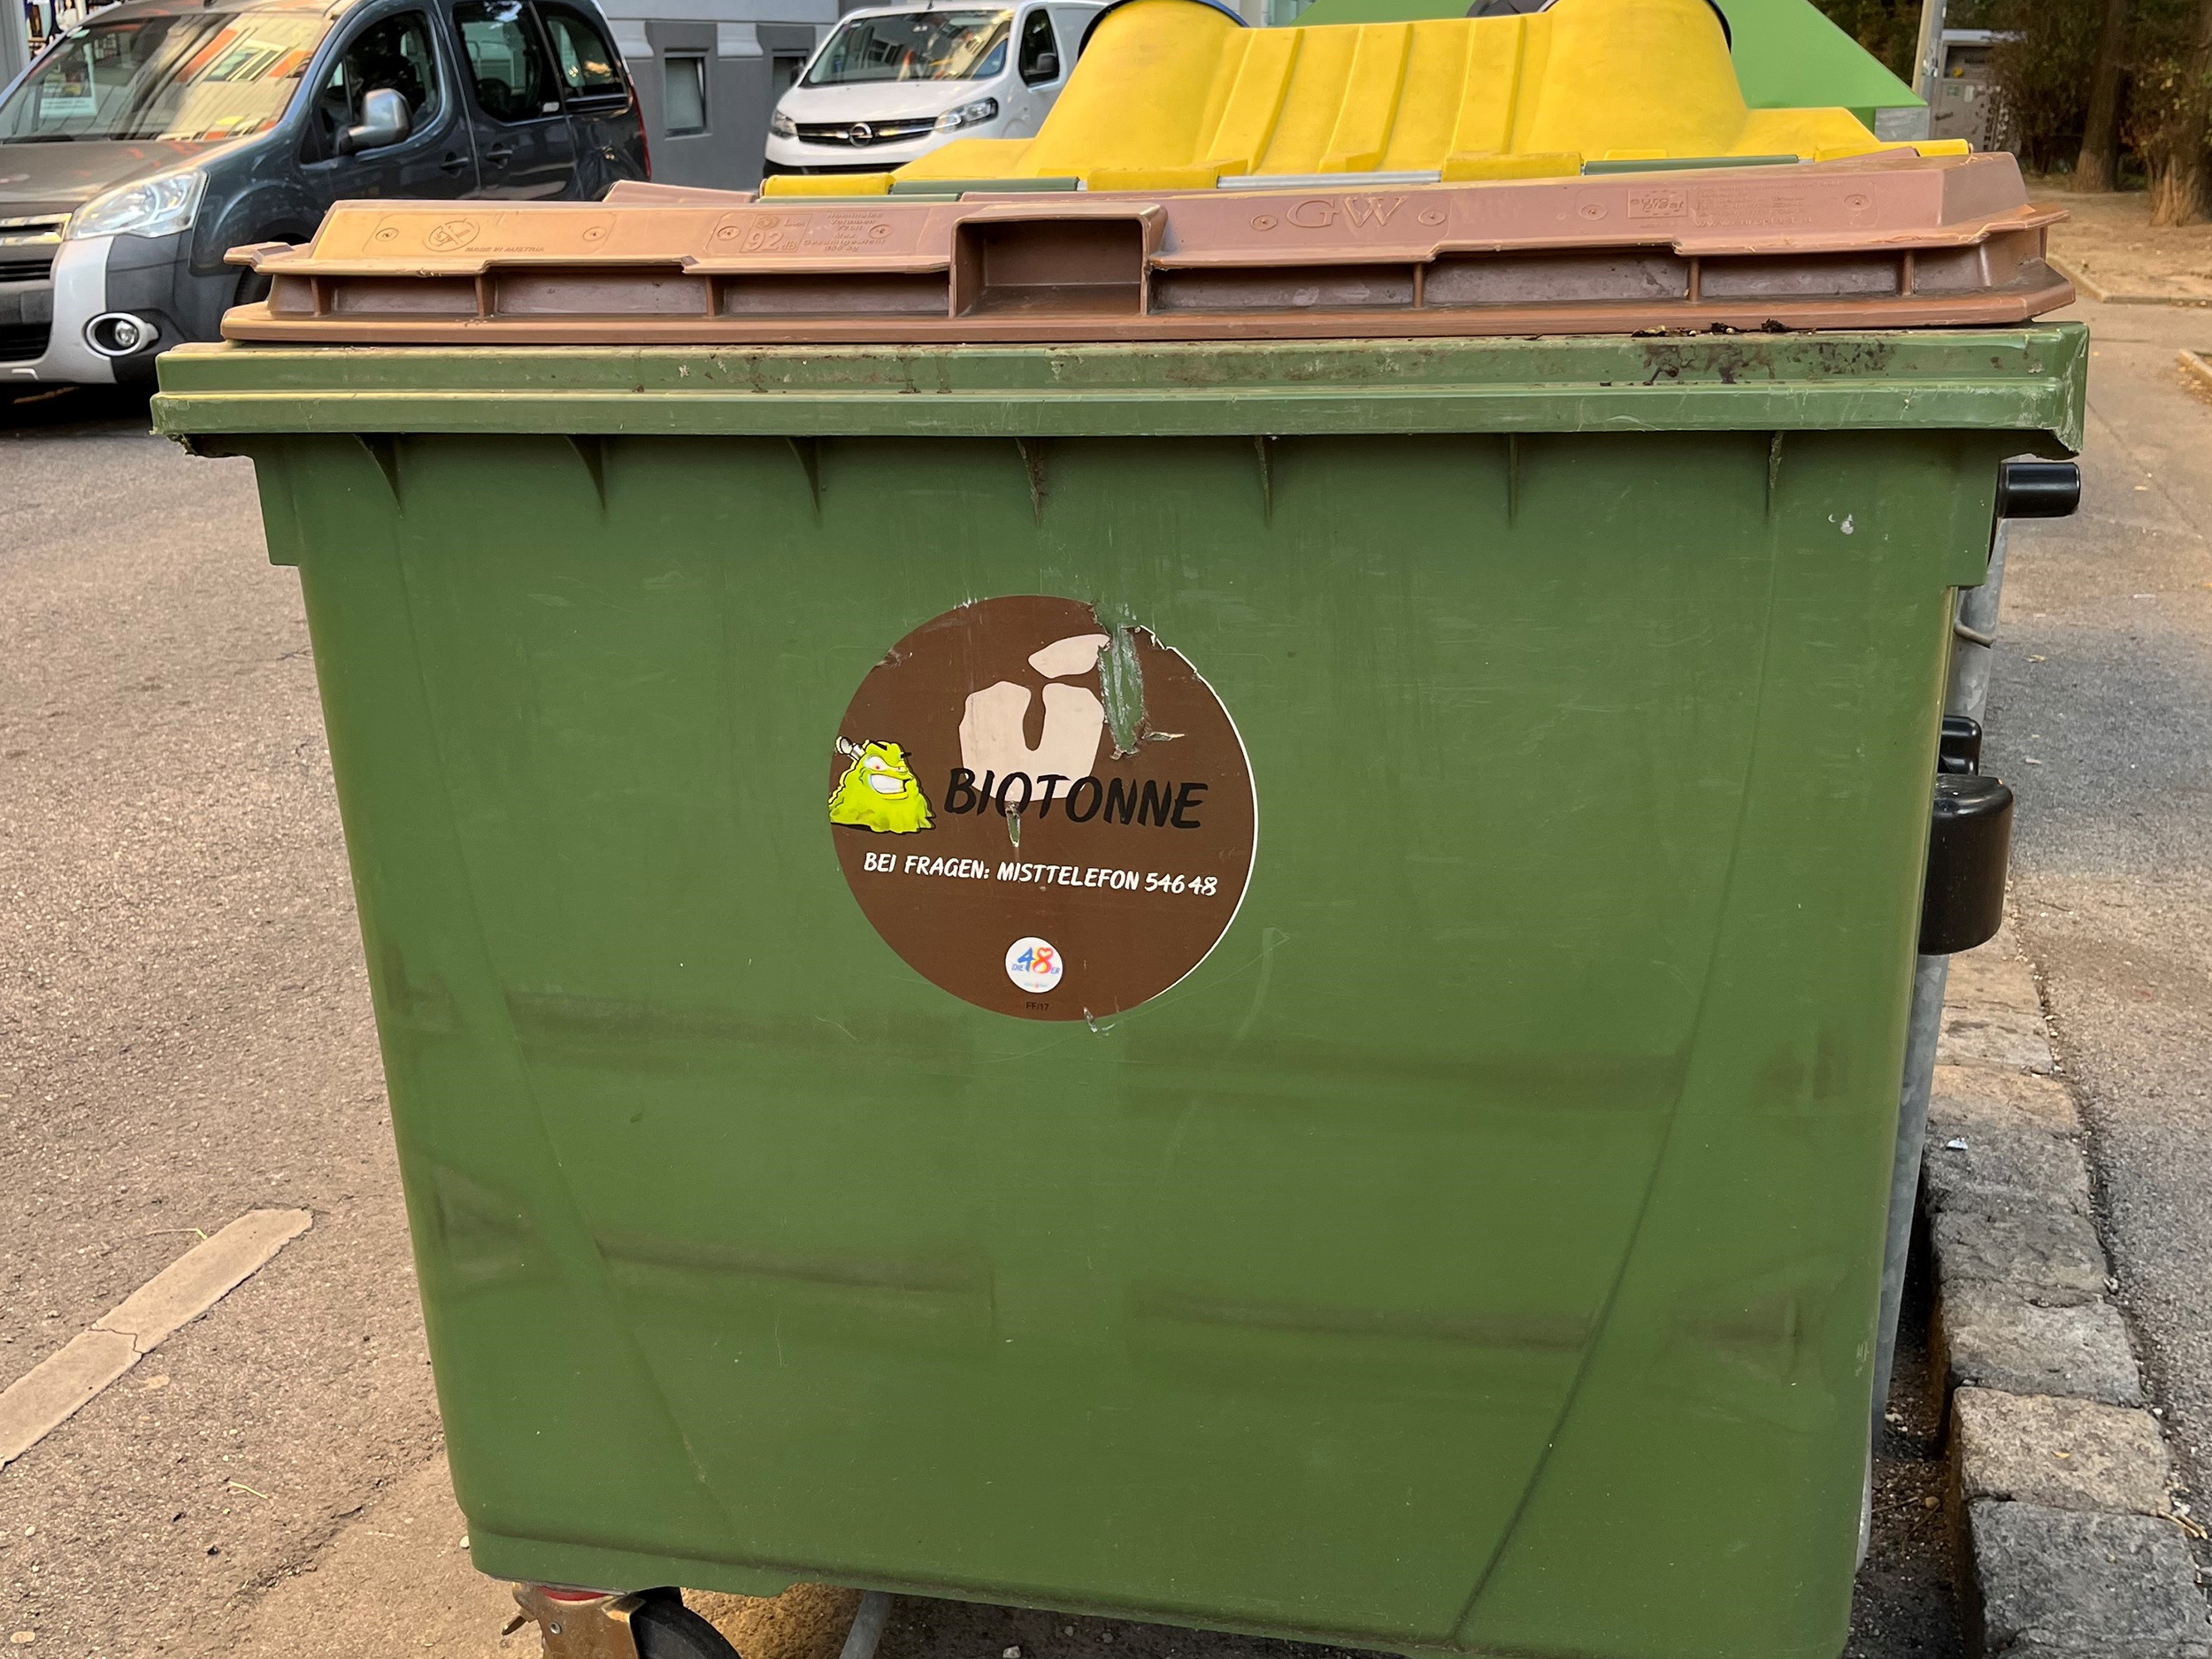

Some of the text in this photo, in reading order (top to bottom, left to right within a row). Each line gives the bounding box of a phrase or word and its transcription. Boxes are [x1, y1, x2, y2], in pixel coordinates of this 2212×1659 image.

[1286, 195, 1408, 228] GW
[747, 230, 797, 251] 92 dB
[943, 767, 1210, 829] BIOTONNE
[864, 851, 897, 873] BEI
[903, 854, 990, 879] FRAGEN:
[996, 861, 1140, 891] MISTTELEFON
